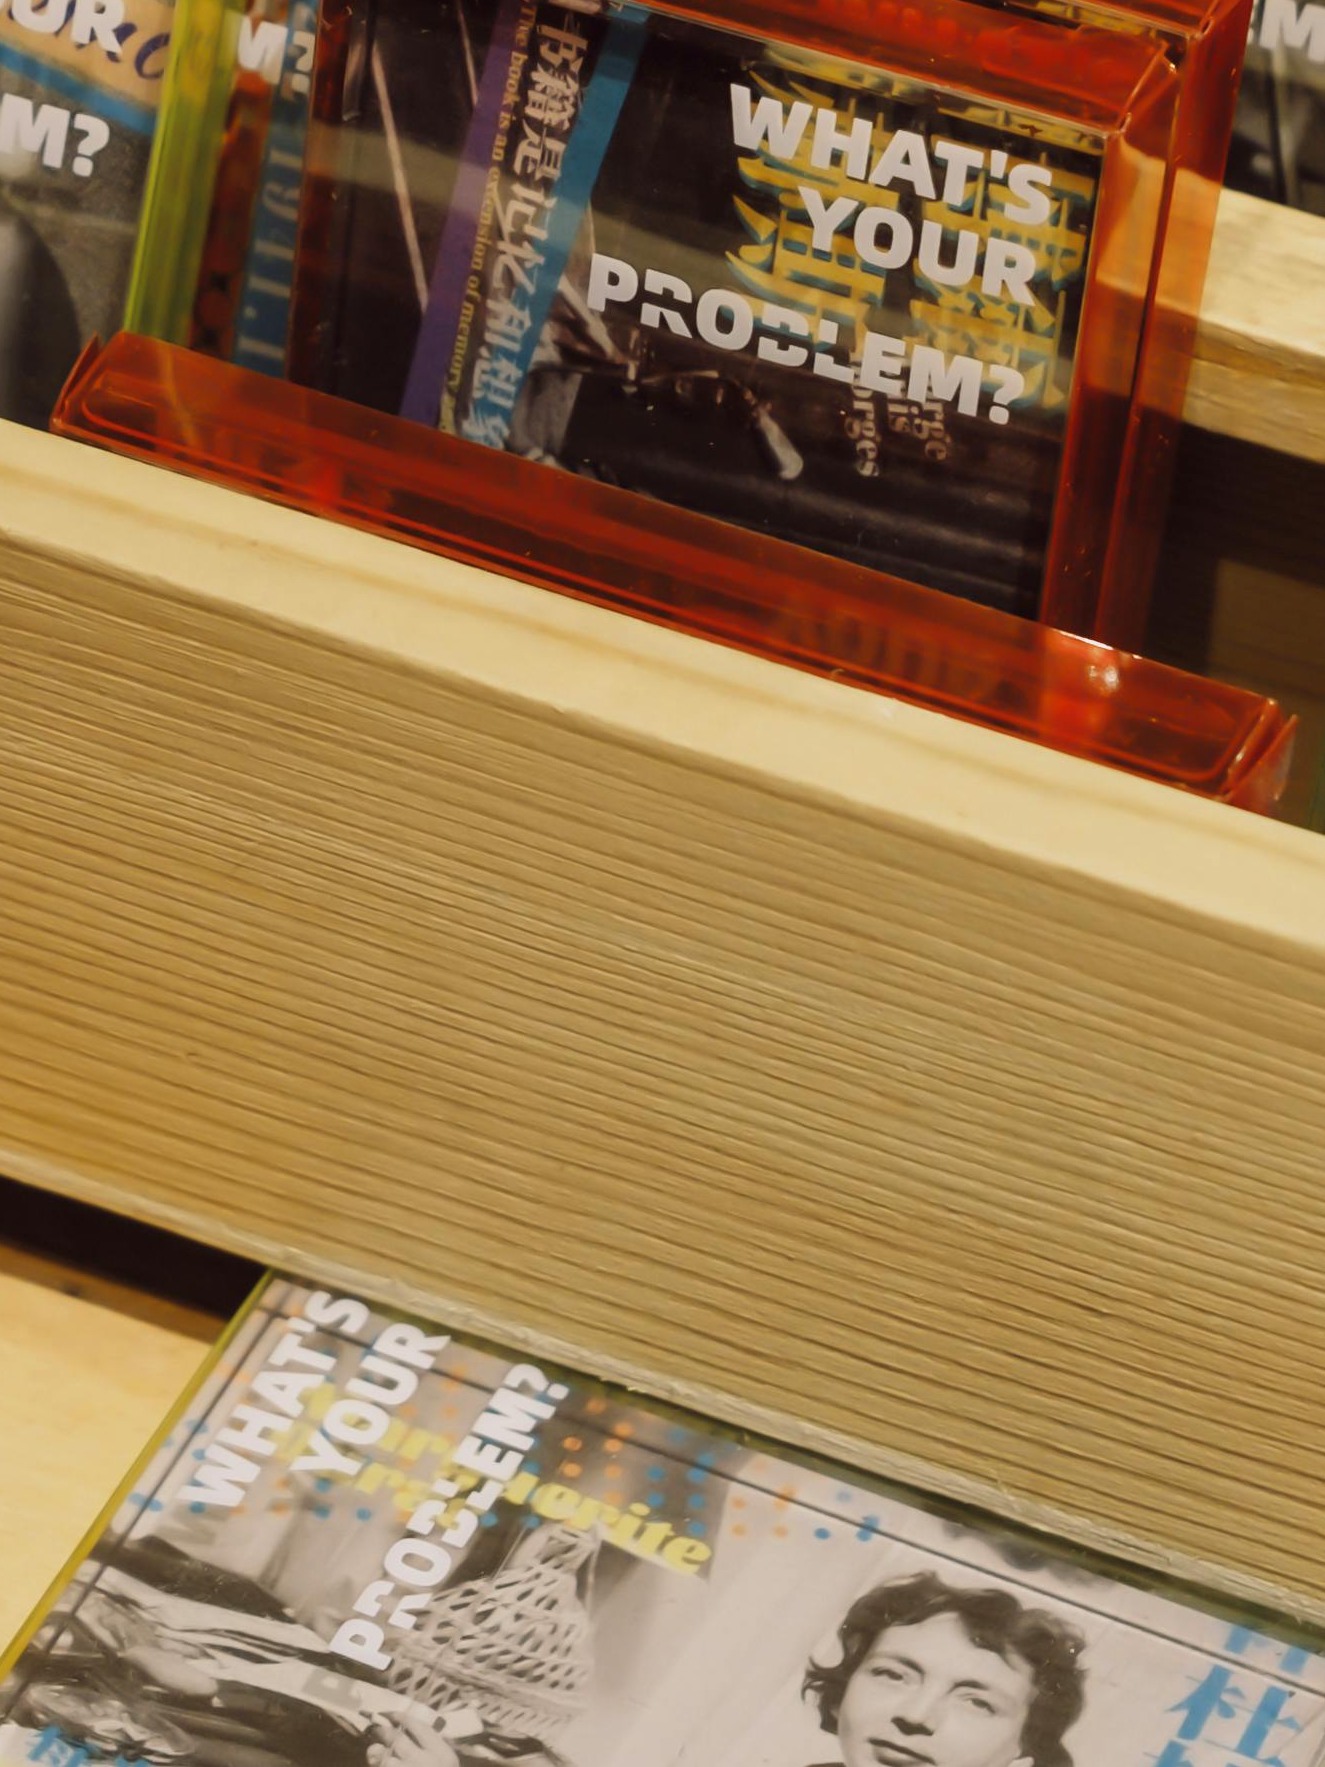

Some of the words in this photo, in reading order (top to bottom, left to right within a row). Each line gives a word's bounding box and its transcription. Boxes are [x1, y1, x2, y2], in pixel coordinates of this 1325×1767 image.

[498, 110, 516, 130] is
[502, 51, 528, 108] book
[492, 134, 507, 162] an
[730, 83, 1052, 226] WHAT'S
[471, 166, 501, 270] extension
[798, 185, 1036, 307] YOUR
[466, 275, 482, 301] of
[587, 252, 1024, 426] PROBLEM?
[443, 302, 475, 392] memory
[178, 1290, 371, 1507] WHAT'S
[291, 1323, 451, 1477] YOUR
[329, 1364, 569, 1671] PROBLEM?
